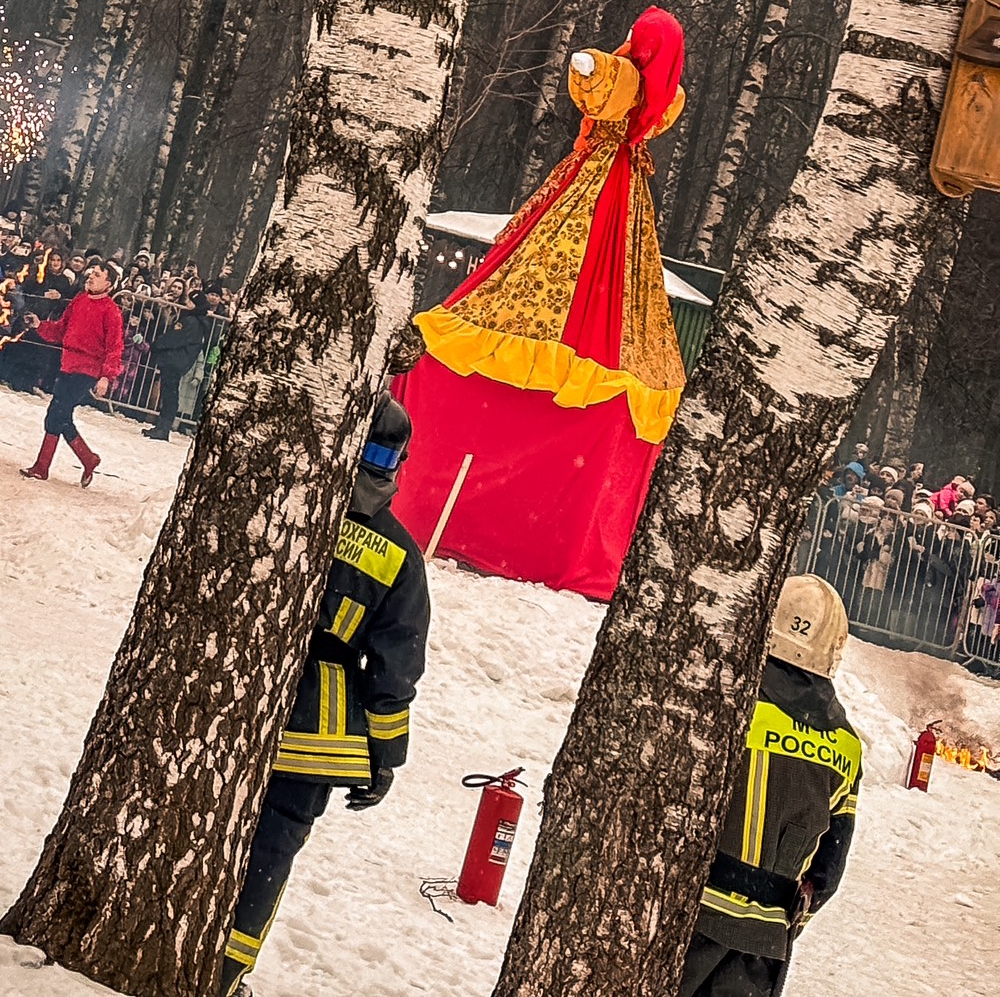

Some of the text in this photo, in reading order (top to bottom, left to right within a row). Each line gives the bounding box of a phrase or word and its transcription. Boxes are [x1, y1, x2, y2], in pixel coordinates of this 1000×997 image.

[336, 538, 364, 564] СИИ
[341, 520, 389, 557] ОХРАНА
[790, 615, 811, 636] 32
[764, 730, 851, 778] РОССИИ
